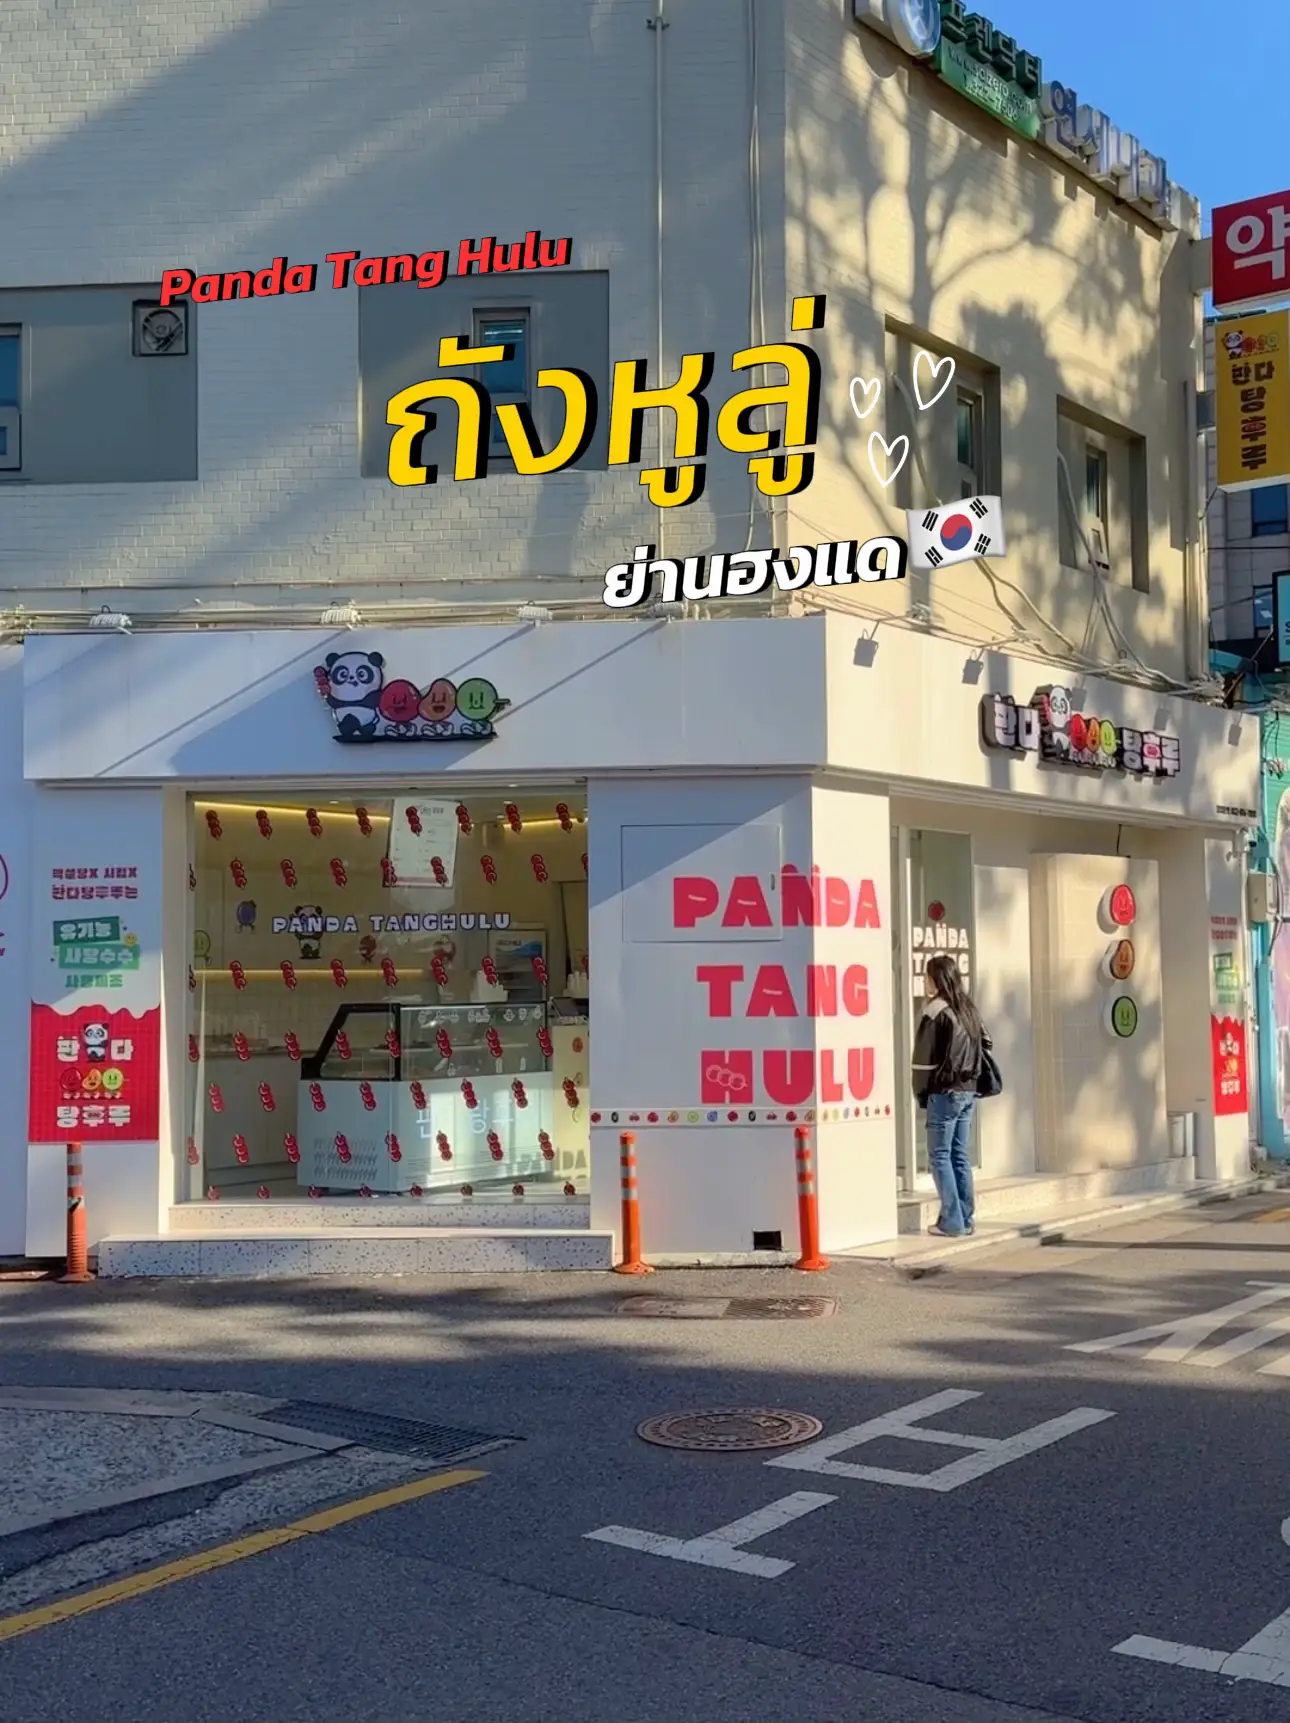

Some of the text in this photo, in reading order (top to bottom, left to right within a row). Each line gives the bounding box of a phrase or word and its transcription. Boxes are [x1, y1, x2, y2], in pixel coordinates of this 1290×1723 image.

[1231, 361, 1275, 386] 판다
[1240, 387, 1267, 470] 탕후루
[994, 692, 1181, 778] 판다 탕후루
[673, 863, 881, 929] PANDA
[60, 921, 112, 941] 유기농
[272, 912, 511, 934] PANDA TANGHULU
[913, 922, 969, 948] PANDA
[65, 947, 133, 964] 사탕수수
[696, 964, 869, 1018] TANG
[701, 1047, 875, 1105] HULU
[56, 1105, 131, 1128] 탕후루
